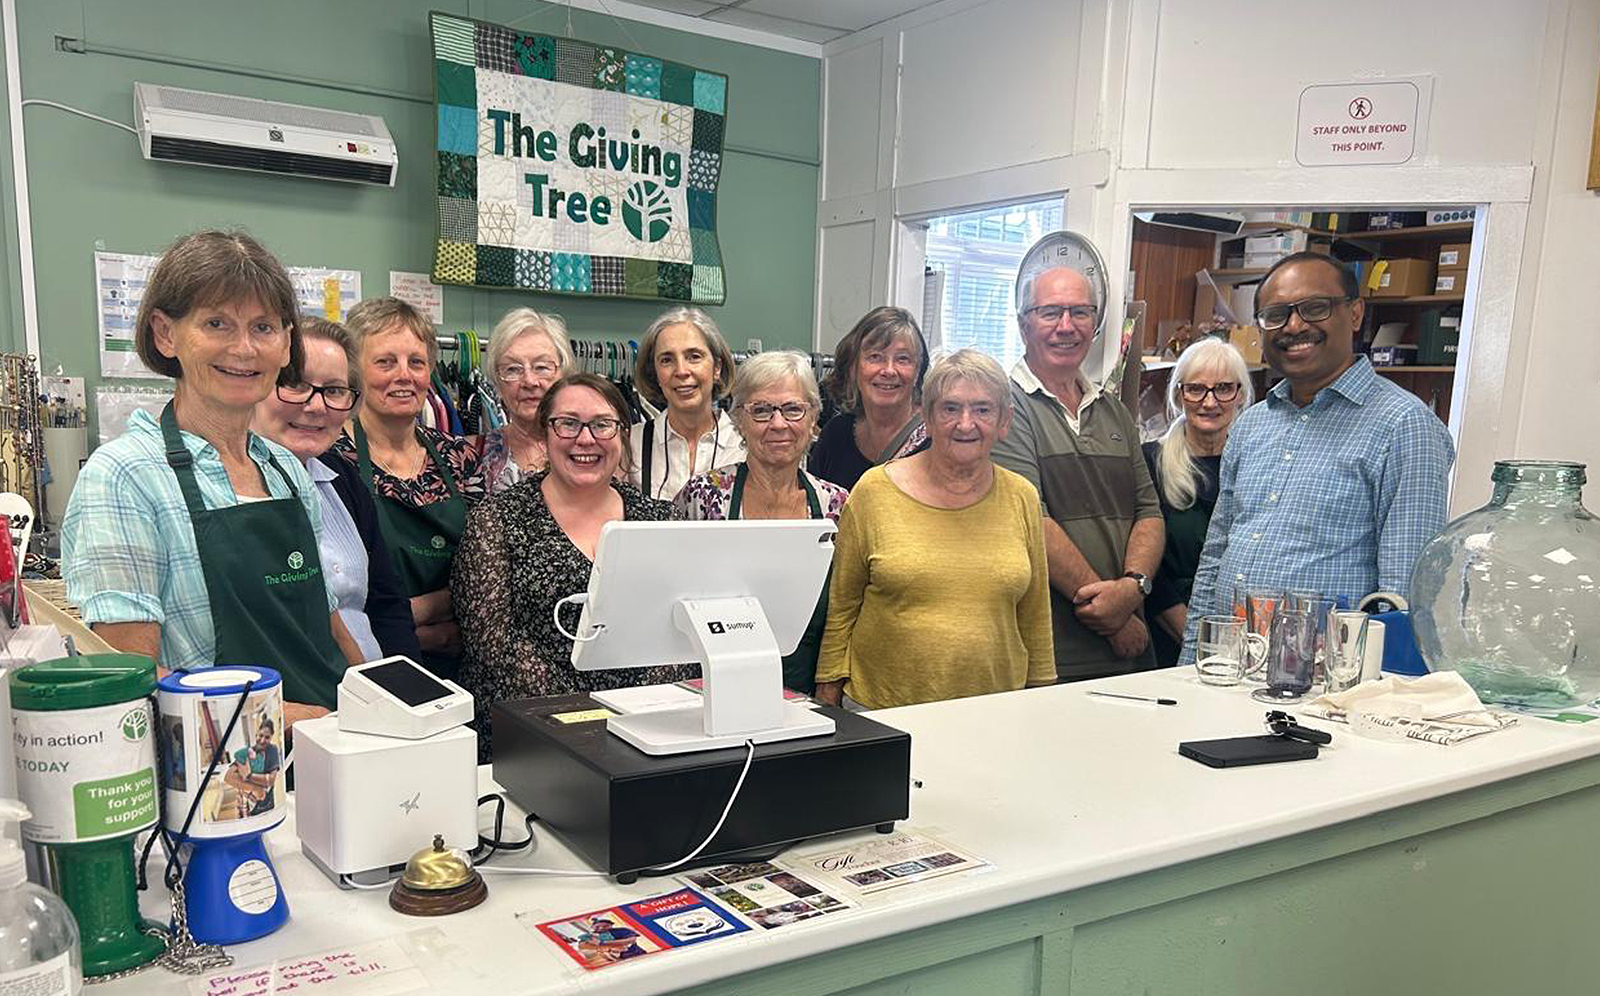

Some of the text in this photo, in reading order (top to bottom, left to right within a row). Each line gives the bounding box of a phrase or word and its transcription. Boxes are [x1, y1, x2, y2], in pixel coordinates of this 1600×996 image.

[1313, 124, 1407, 136] STAFF ONLY BEYOND
[487, 108, 681, 188] The Giving
[1332, 141, 1385, 152] THIS POINT.
[525, 173, 611, 225] Tree
[1056, 246, 1068, 257] 12
[264, 574, 280, 586] The
[30, 733, 43, 747] in
[47, 730, 104, 747] action!
[21, 758, 70, 772] TODAY
[89, 776, 152, 799] Thank you
[108, 789, 153, 810] for your
[105, 800, 154, 824] support!
